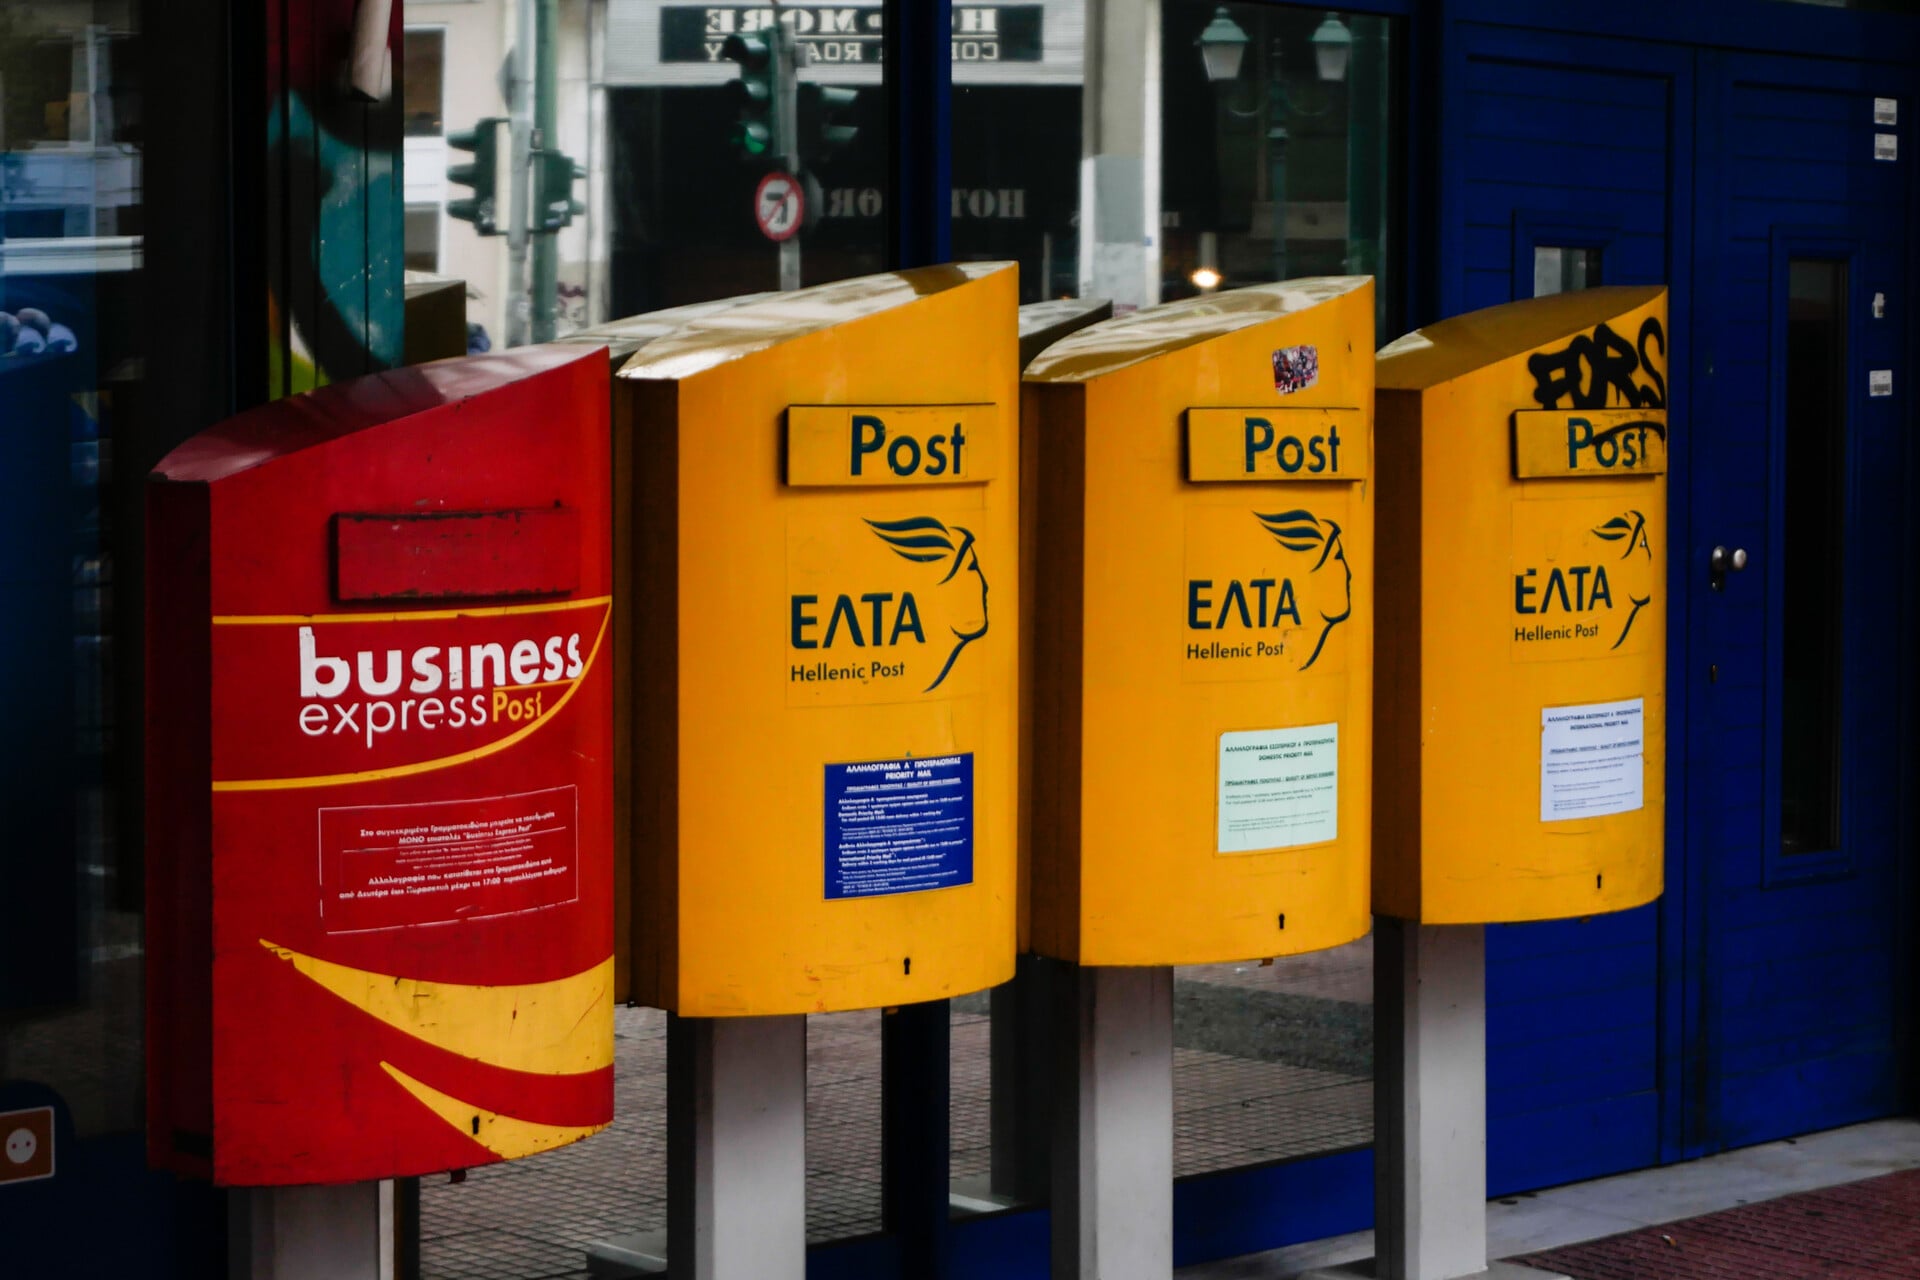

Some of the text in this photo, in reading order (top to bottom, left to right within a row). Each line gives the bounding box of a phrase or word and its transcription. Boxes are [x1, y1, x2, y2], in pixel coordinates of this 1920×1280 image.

[850, 415, 965, 476] Post
[1244, 417, 1340, 473] Post
[1567, 417, 1648, 469] Post
[791, 591, 926, 649] ΕΛΤΑ
[1188, 578, 1302, 630] ΕΛΤΑ
[1187, 642, 1284, 660] Hellenic Post
[1514, 623, 1599, 641] Hellenic Post
[299, 626, 584, 698] business
[791, 661, 905, 682] Hellenic Post
[299, 690, 542, 749] express Post
